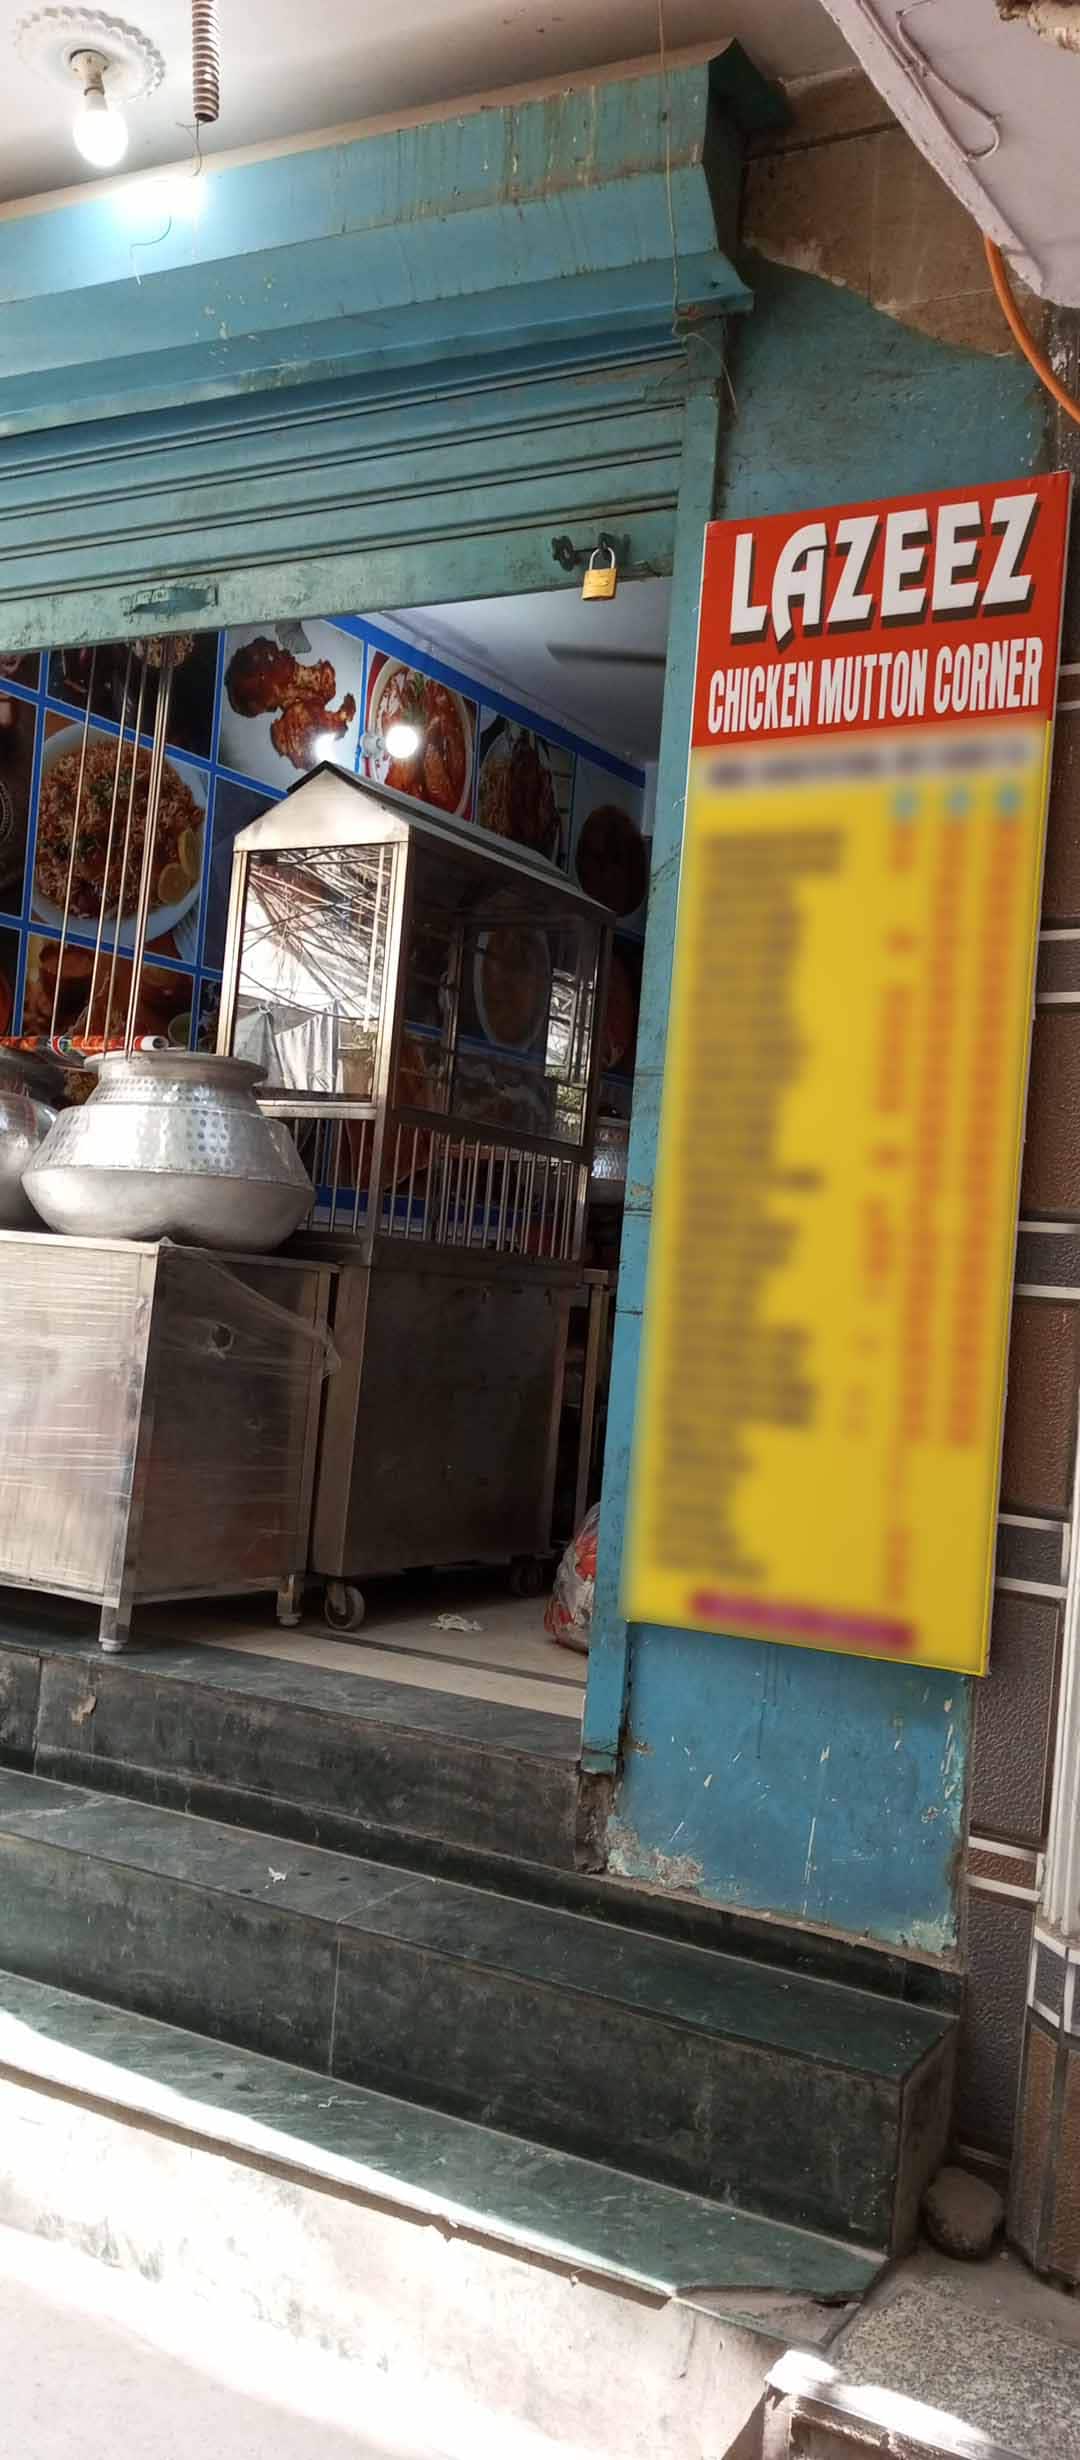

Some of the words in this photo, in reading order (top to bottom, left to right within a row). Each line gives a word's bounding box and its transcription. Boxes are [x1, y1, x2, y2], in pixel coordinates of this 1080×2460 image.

[730, 492, 1038, 645] LAZEEZ
[707, 660, 814, 734] CHICKEN
[817, 648, 929, 725] MUTTON
[932, 636, 1043, 715] CORNER
